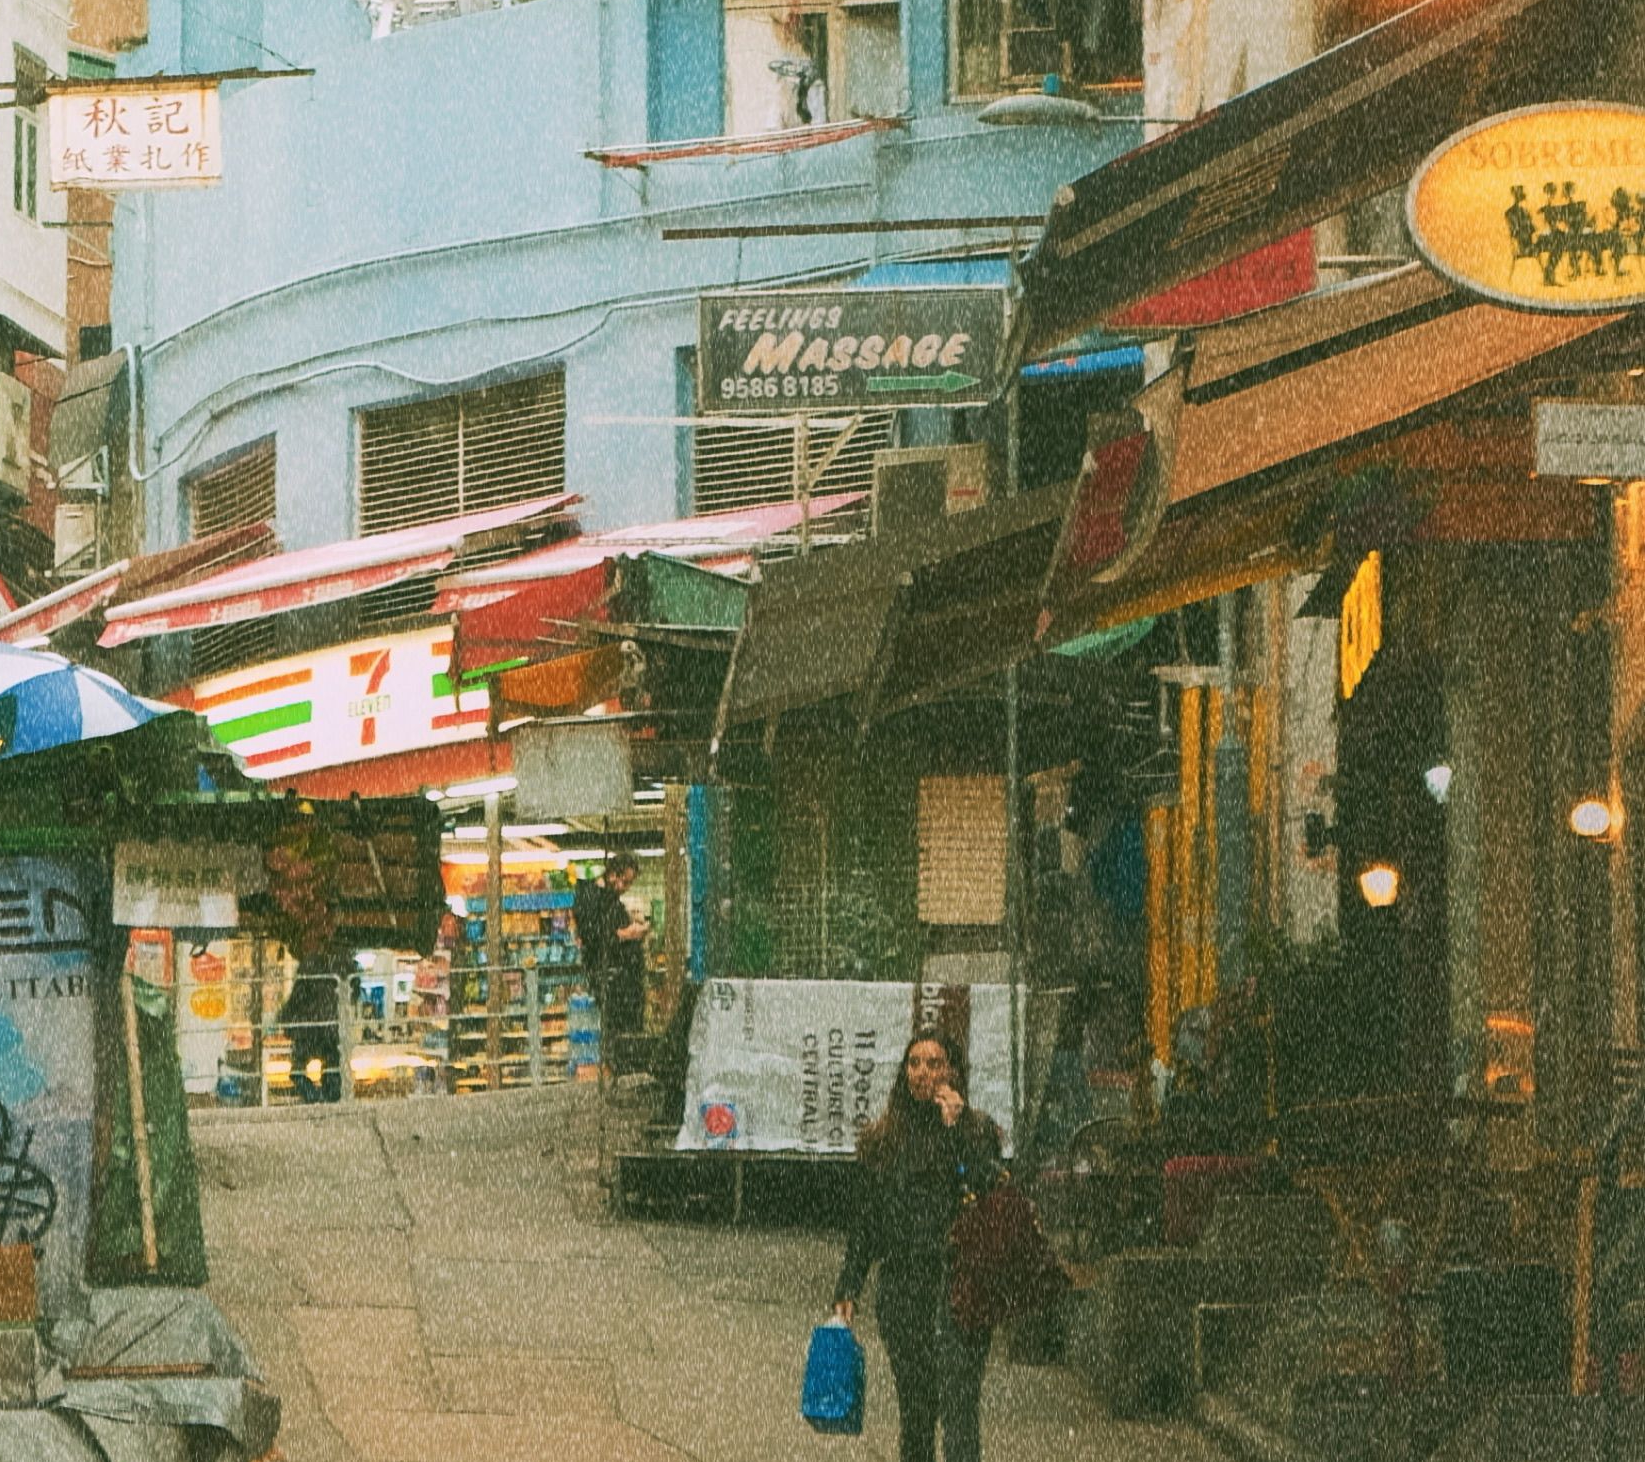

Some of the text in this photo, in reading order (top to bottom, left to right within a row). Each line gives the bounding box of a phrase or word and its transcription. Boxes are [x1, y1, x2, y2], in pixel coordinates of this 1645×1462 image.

[83, 97, 189, 138] 秋記
[718, 306, 842, 331] FEELINGS
[743, 330, 971, 375] MASSAGE
[720, 375, 838, 399] 9586 8185
[350, 648, 391, 745] 7
